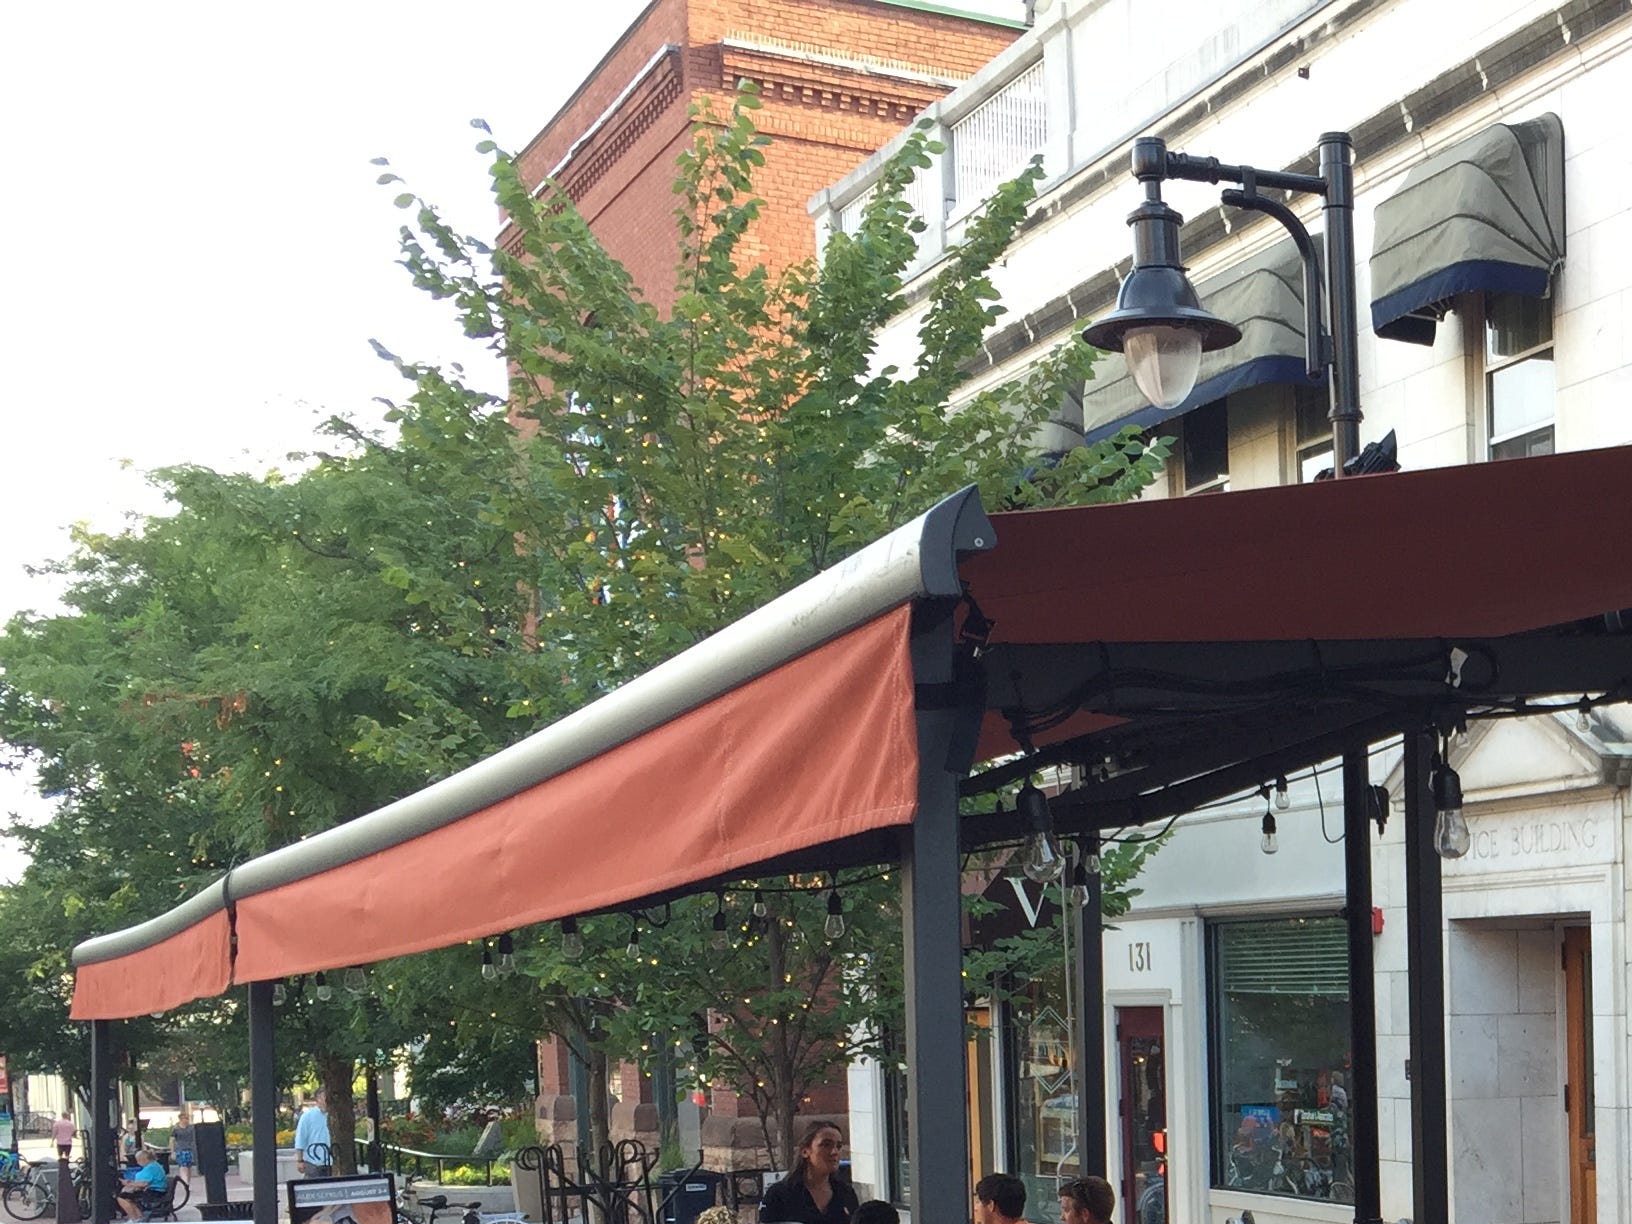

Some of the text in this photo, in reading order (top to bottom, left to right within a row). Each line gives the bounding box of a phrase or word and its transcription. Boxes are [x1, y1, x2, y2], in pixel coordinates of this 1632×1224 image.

[1465, 817, 1599, 861] ICE BUILDING
[1128, 942, 1152, 972] 131
